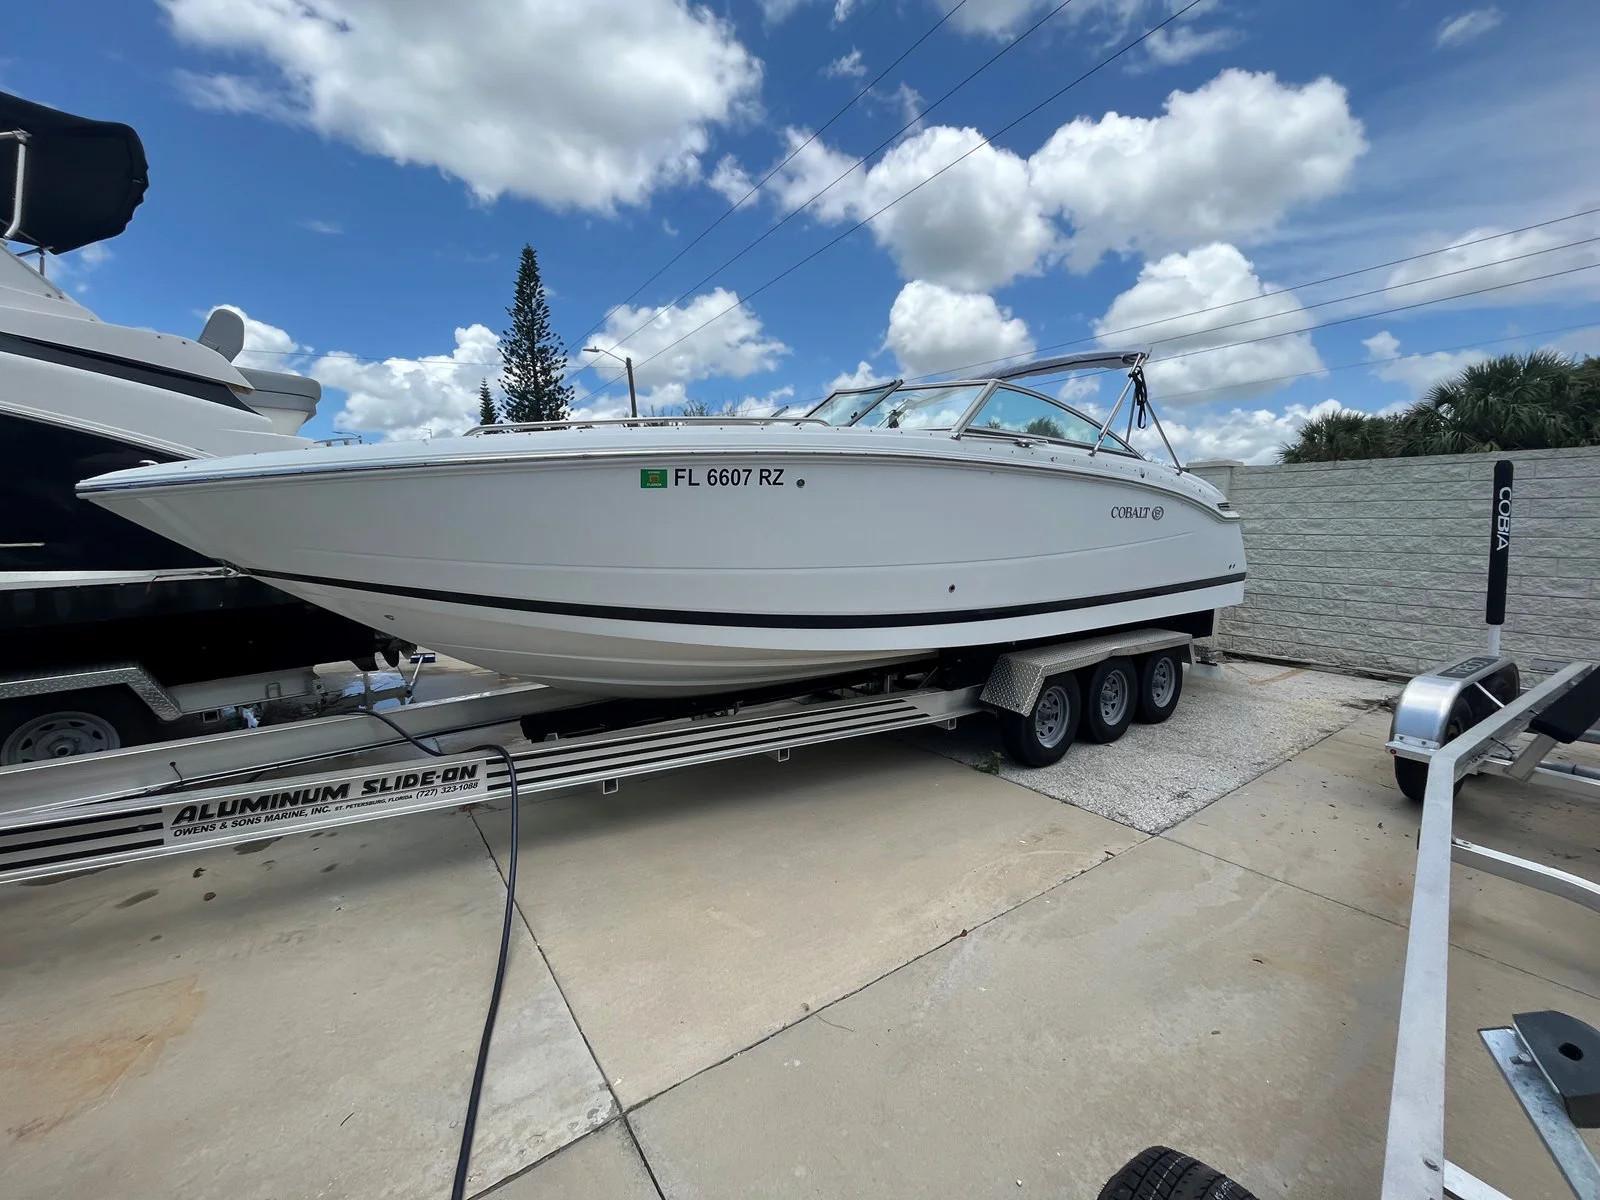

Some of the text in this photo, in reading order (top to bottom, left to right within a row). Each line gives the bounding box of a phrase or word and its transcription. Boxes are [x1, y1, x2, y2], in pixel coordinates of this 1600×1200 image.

[674, 468, 785, 487] FL 6607 RZ
[1111, 506, 1151, 519] COBALT
[1496, 486, 1512, 551] COBIA
[172, 764, 479, 826] ALUMINUM SLIDE-ON
[173, 823, 217, 837] OWENS
[219, 821, 228, 830] &
[231, 816, 262, 828] SONS
[263, 810, 308, 823] MARINE,
[311, 805, 331, 815] INC.
[388, 794, 413, 803] FLORIDA
[416, 789, 438, 800] (727)
[441, 782, 479, 794] 323-1088
